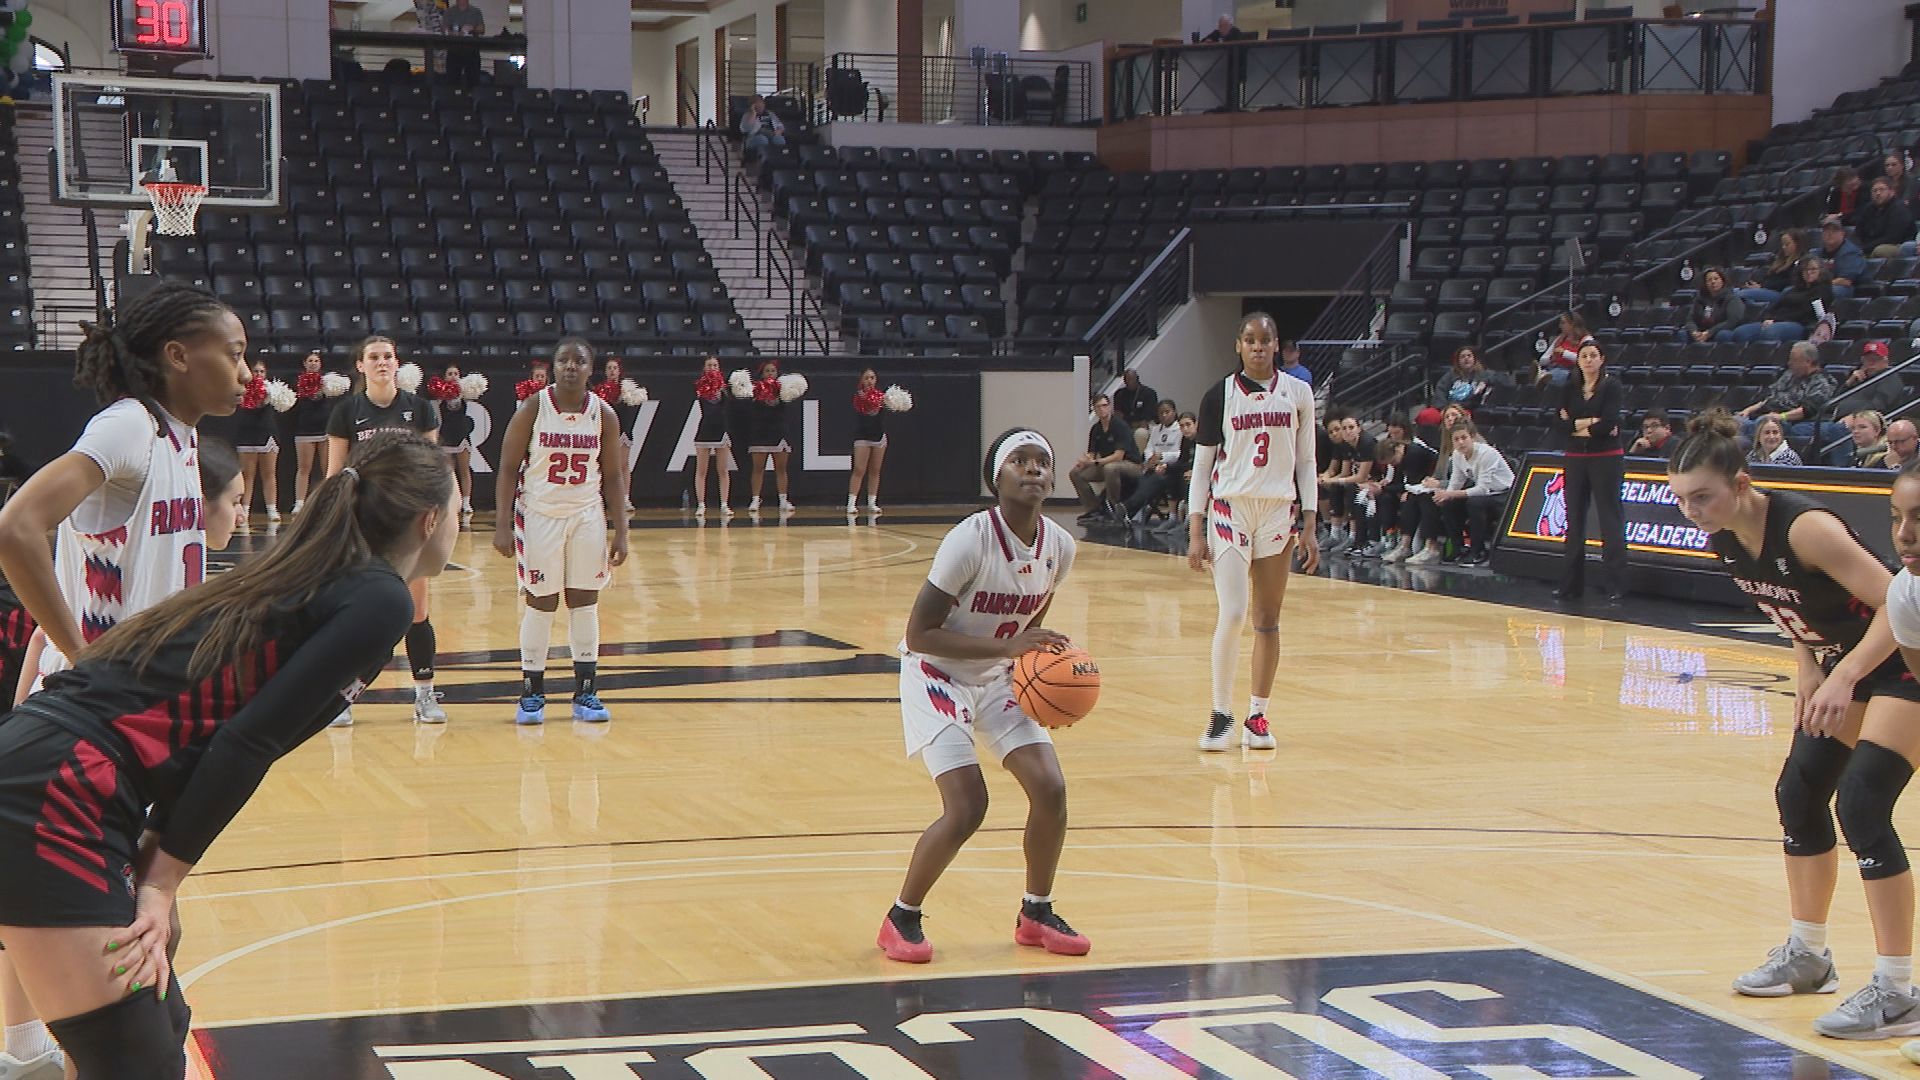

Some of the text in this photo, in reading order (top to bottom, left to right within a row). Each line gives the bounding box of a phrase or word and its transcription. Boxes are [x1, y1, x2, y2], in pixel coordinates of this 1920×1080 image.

[136, 0, 188, 45] 30
[1231, 411, 1291, 431] FRANCIS MARION
[1253, 432, 1270, 468] 3
[547, 452, 590, 485] 25
[1620, 481, 1680, 505] BELMO
[1624, 520, 1710, 549] USADERS
